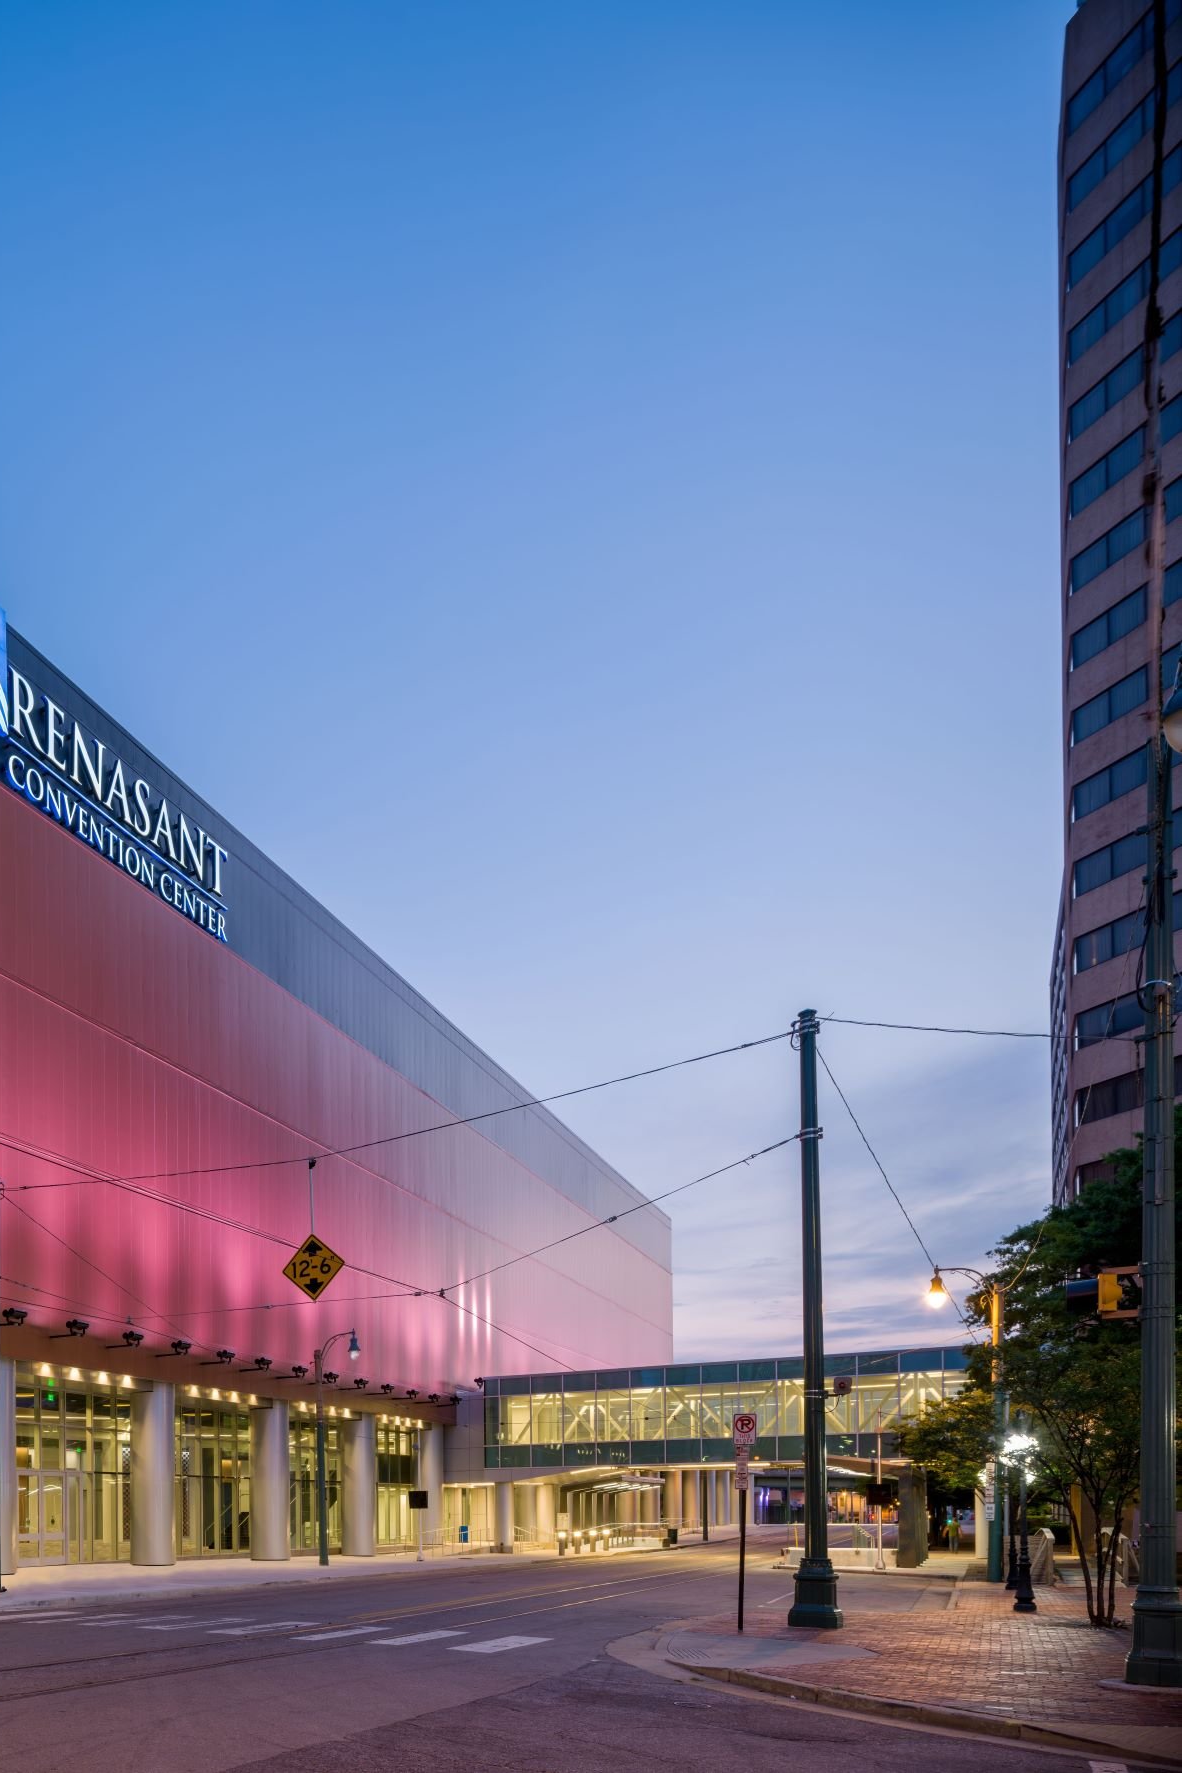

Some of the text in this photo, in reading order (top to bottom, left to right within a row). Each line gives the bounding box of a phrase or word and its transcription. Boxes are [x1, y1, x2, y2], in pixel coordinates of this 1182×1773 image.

[8, 755, 228, 941] CONVENTION CENTER
[9, 665, 228, 896] RENASANT
